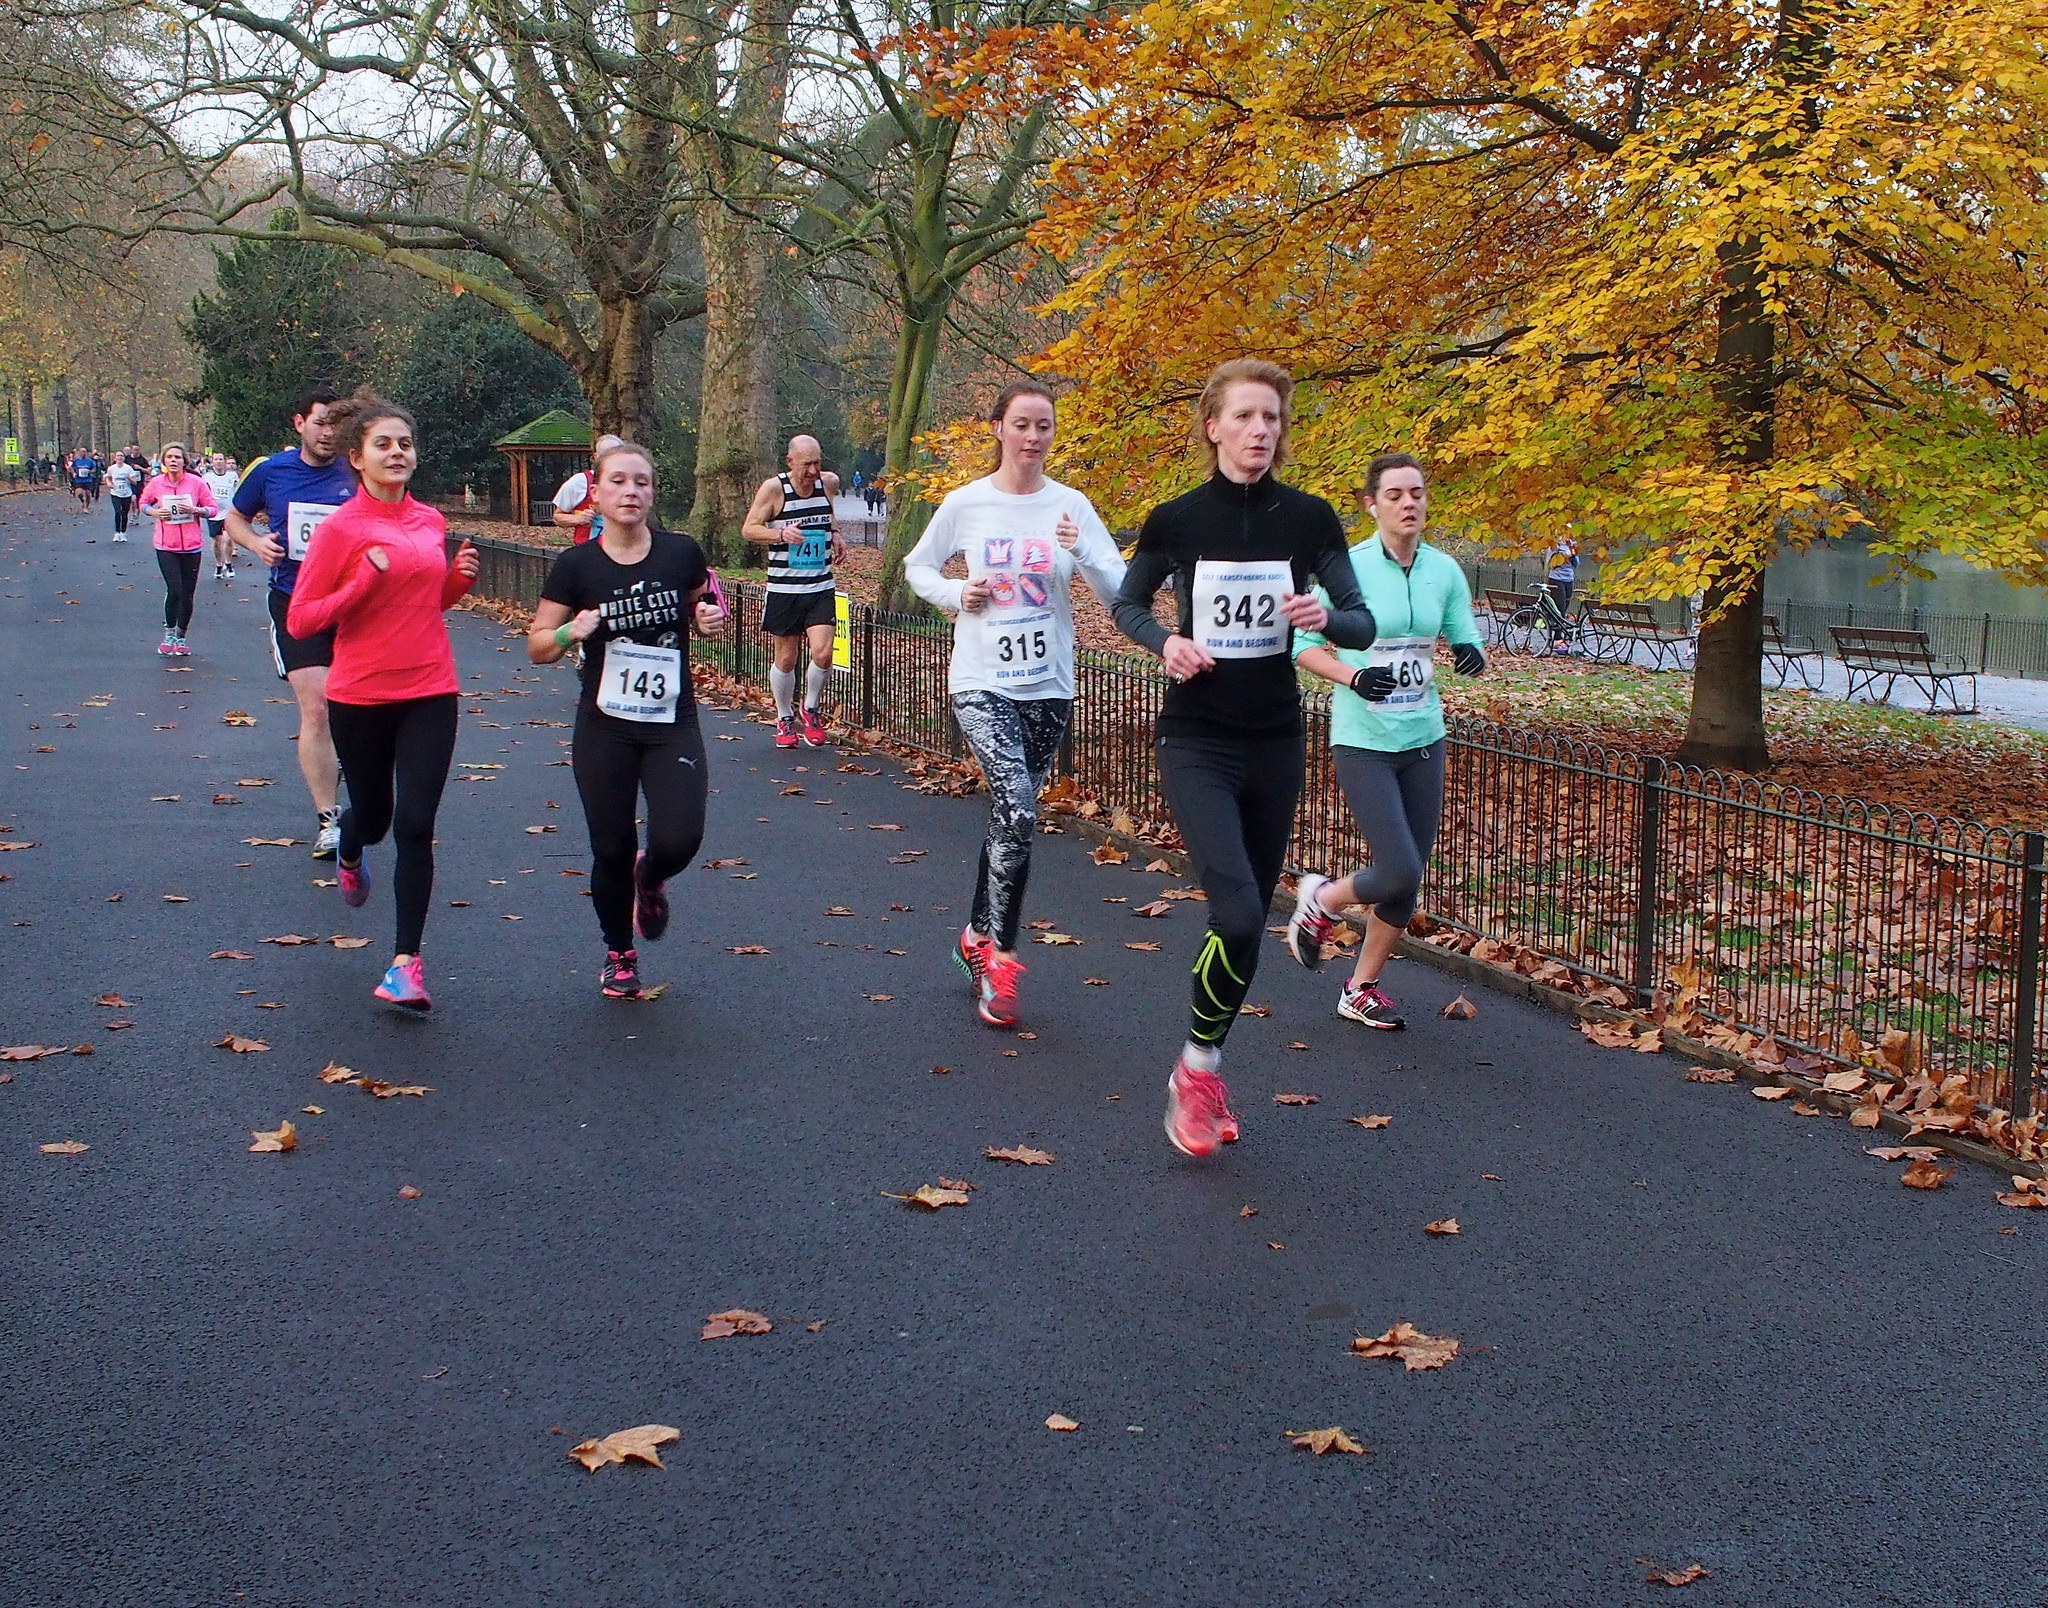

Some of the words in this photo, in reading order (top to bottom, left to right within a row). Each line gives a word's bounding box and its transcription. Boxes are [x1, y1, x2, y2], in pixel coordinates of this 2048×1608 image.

[796, 542, 819, 558] 741
[599, 596, 643, 618] WHITE
[648, 589, 680, 609] CITY
[1213, 594, 1276, 629] 342
[607, 607, 679, 632] WHIPPETS
[998, 630, 1046, 662] 315
[1225, 638, 1243, 648] AND
[1245, 636, 1279, 648] BECOME
[620, 667, 666, 700] 143
